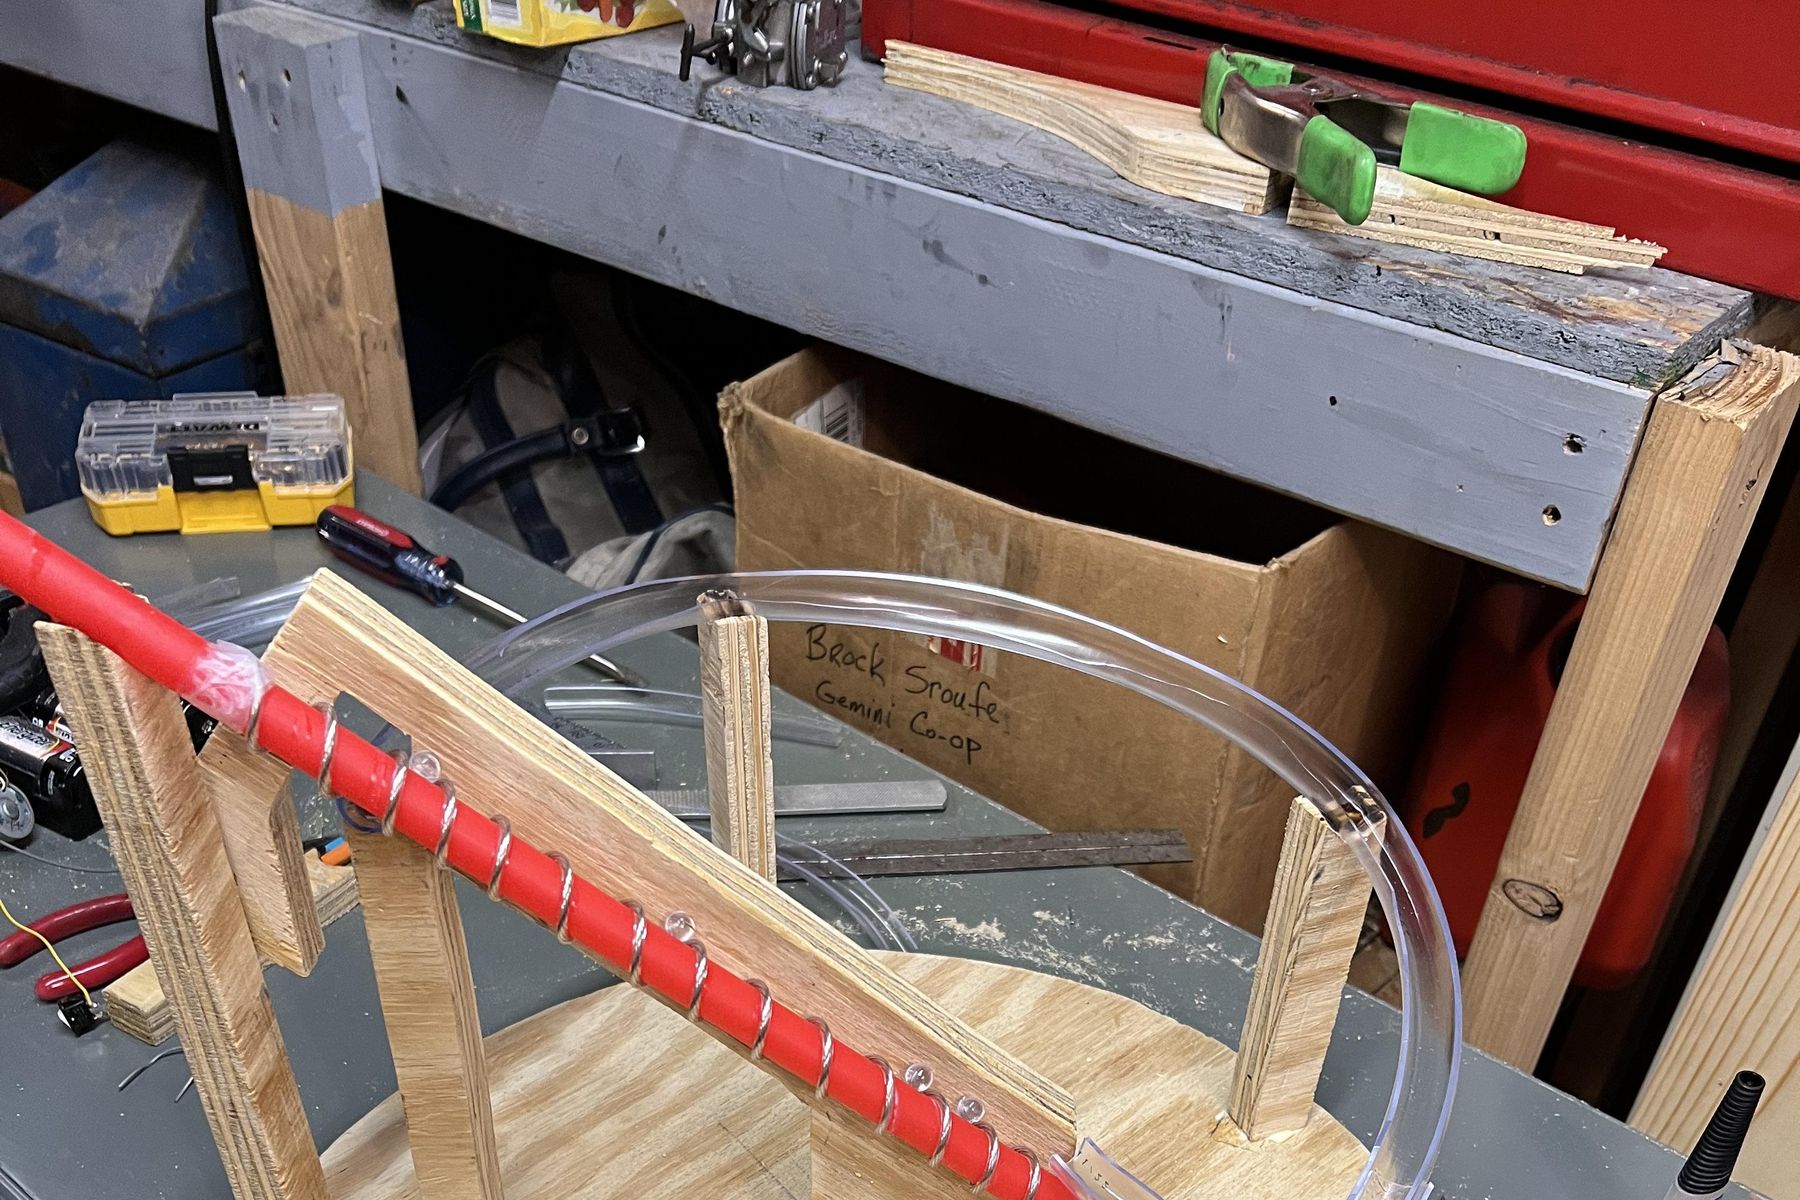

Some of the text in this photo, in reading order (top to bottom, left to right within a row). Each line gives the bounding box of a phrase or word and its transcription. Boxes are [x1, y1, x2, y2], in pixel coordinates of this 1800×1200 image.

[815, 680, 982, 765] Gemini Co-op
[904, 665, 1000, 723] Sroufe
